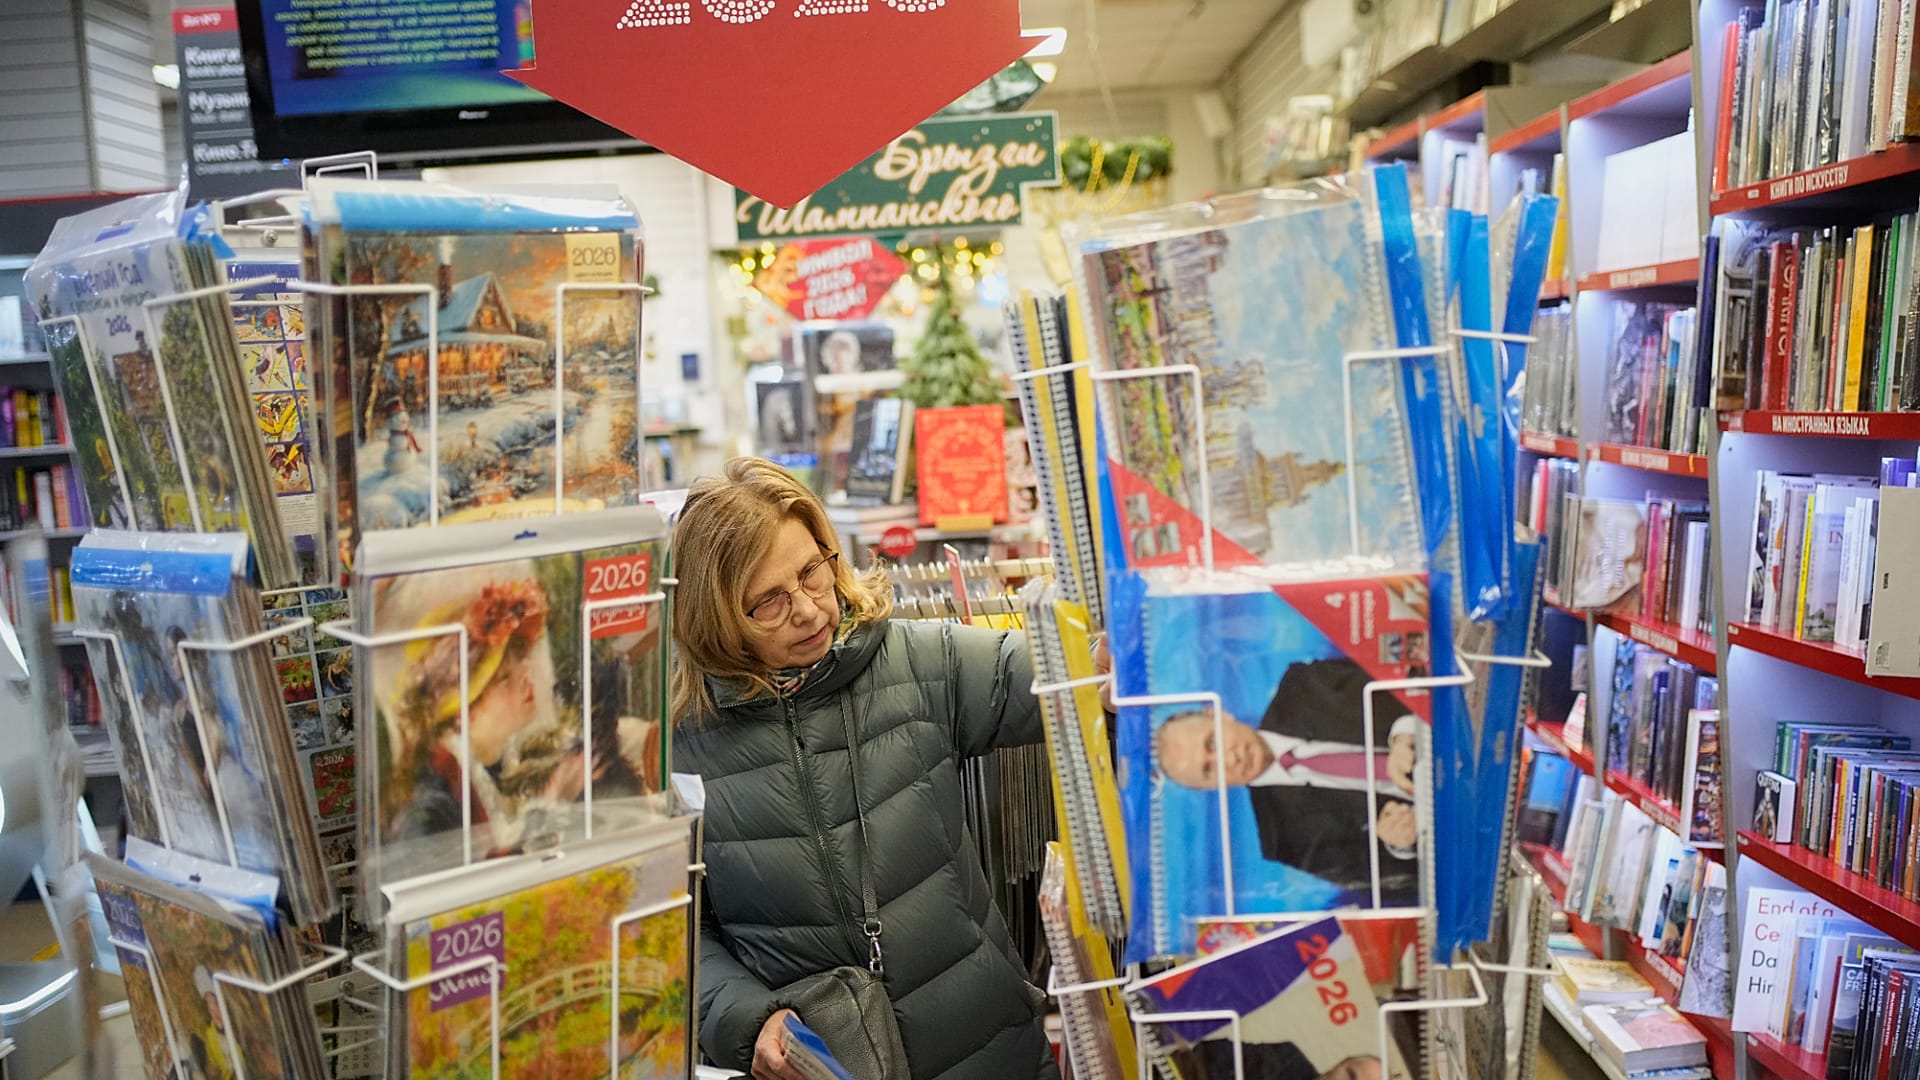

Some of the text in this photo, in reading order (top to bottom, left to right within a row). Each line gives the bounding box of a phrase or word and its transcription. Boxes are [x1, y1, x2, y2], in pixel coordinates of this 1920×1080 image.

[1770, 179, 1794, 201] КНИГИ
[1794, 176, 1805, 195] ПО
[1805, 165, 1849, 193] ИСКУССТВУ
[735, 174, 1020, 237] Шампанского
[571, 246, 616, 267] 2026
[1771, 415, 1870, 436] НА ИНОСТРАННЫХ ЯЗЫКАХ
[588, 560, 647, 594] 2026
[435, 917, 502, 964] 2026
[1751, 949, 1778, 968] Da
[1295, 933, 1359, 1027] 2026
